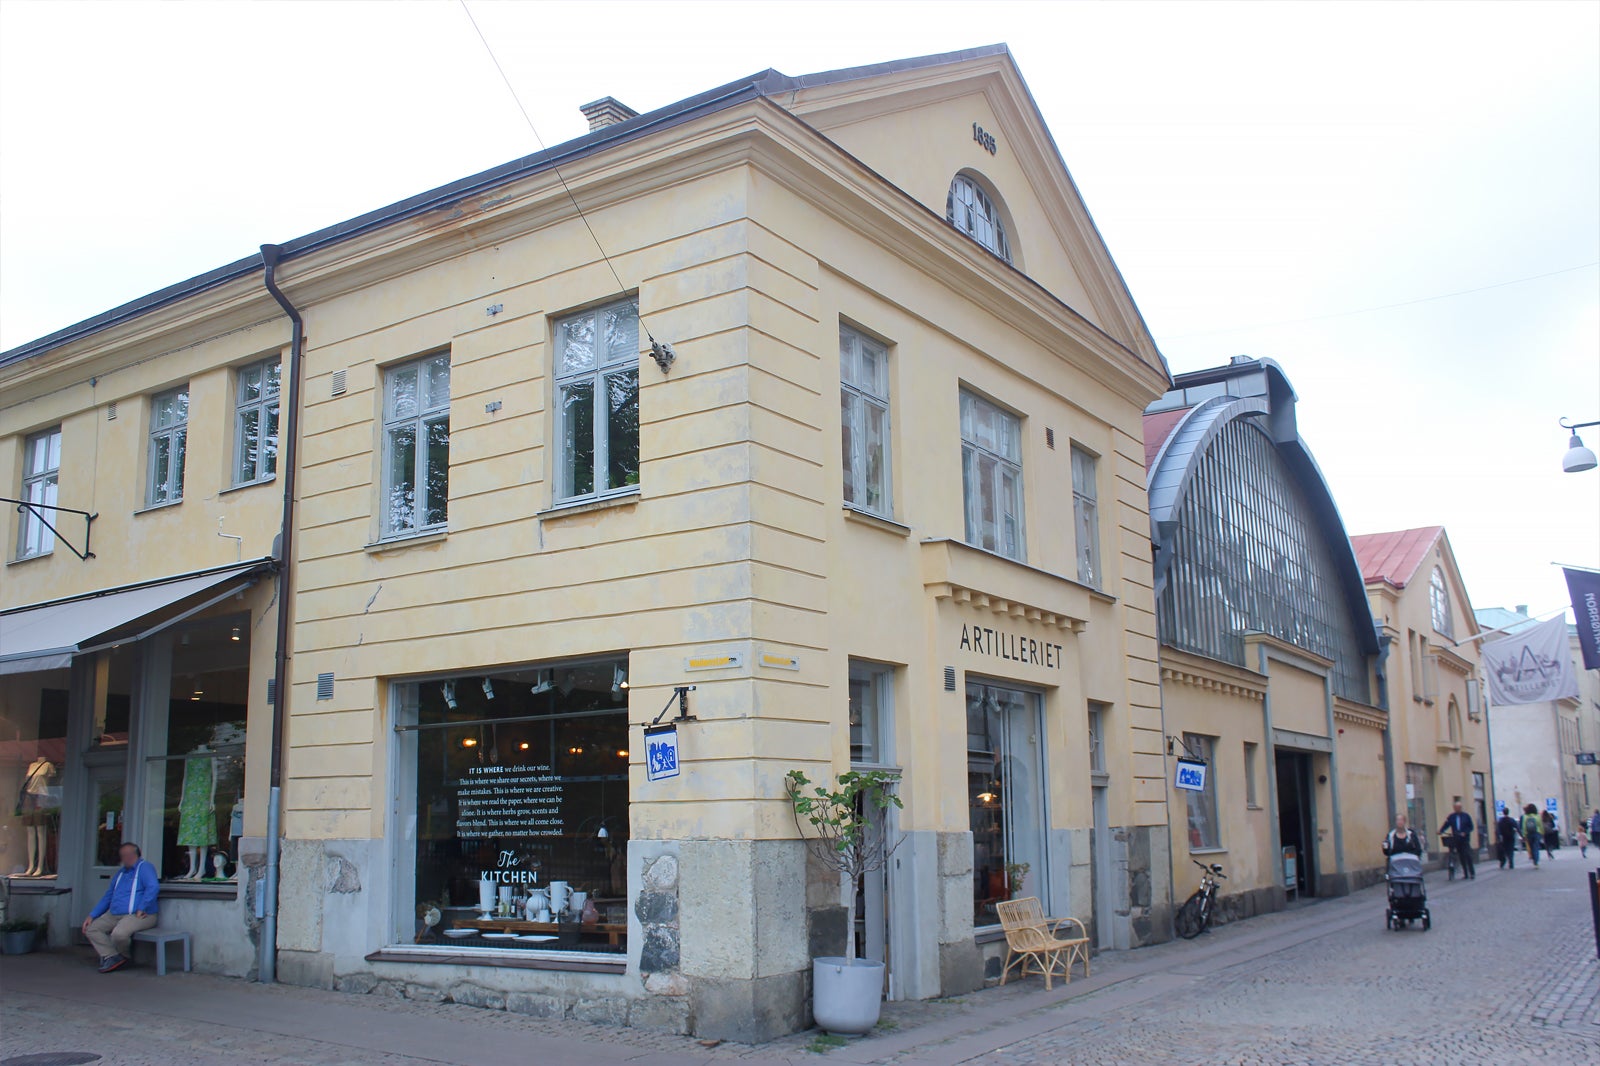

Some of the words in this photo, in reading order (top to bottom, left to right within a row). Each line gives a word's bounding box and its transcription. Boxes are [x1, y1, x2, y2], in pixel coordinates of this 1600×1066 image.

[960, 623, 1062, 670] ARTILLERIET
[497, 850, 520, 868] The
[481, 870, 537, 884] KITCHEN
